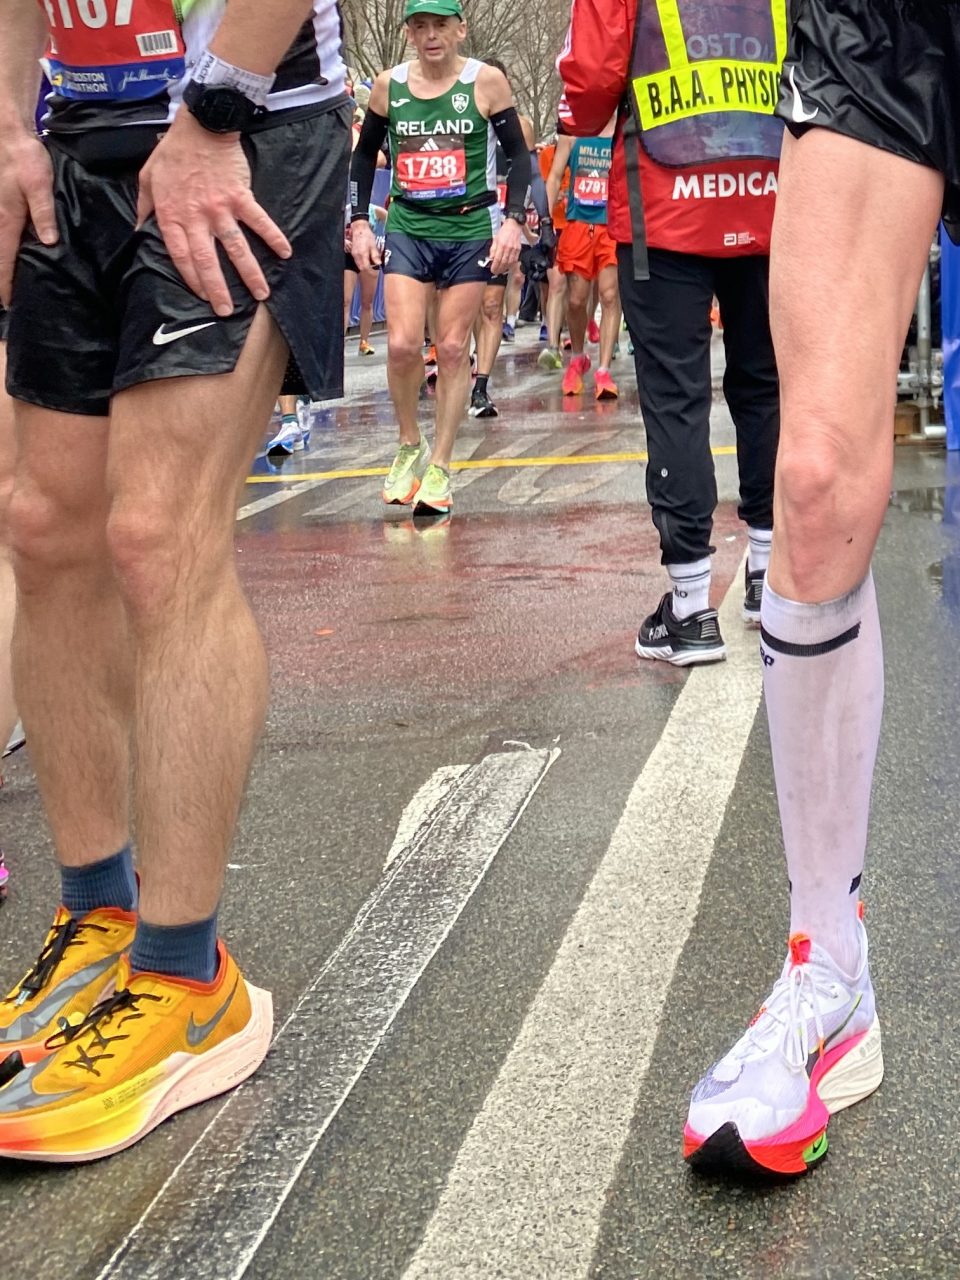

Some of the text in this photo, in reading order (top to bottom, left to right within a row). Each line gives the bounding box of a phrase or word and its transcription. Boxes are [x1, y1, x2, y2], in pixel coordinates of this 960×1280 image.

[686, 32, 774, 61] OSTO
[647, 69, 714, 119] B.A.A.
[404, 155, 457, 180] 1738
[672, 171, 778, 200] MEDICA
